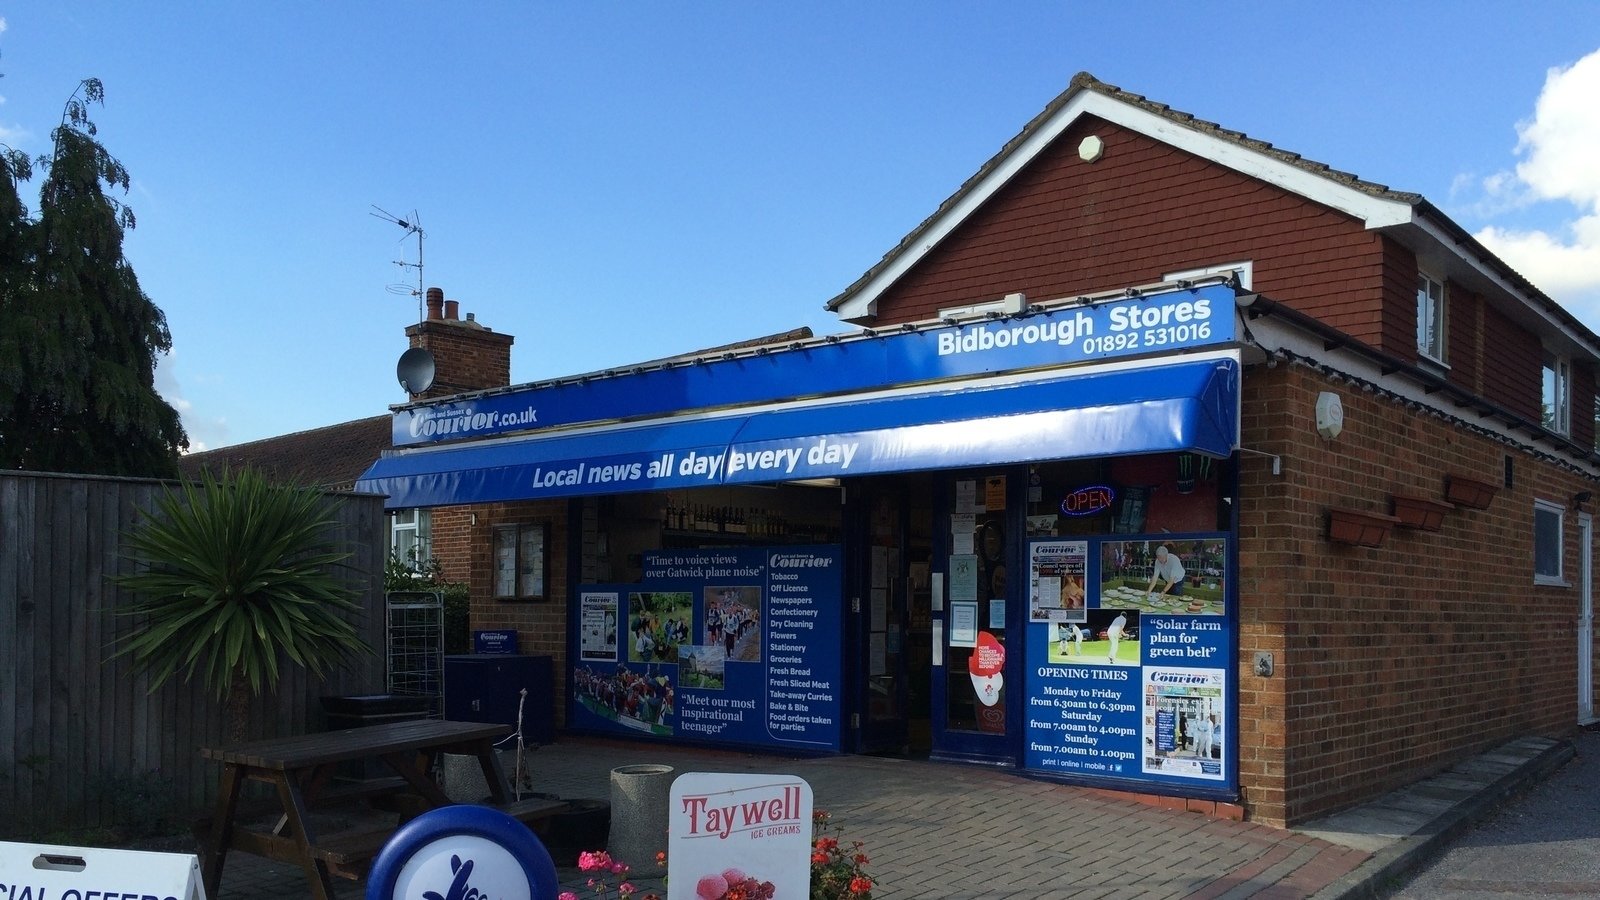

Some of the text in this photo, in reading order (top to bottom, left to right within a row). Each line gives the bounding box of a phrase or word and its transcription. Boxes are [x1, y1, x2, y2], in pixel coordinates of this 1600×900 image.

[938, 299, 1211, 355] Bidborough Stores
[1083, 321, 1211, 354] 01892 531016
[533, 439, 859, 488] Local news all day every day
[1065, 490, 1112, 512] OPEN
[674, 556, 684, 565] to
[685, 554, 710, 565] voice
[711, 553, 738, 564] views
[770, 553, 833, 568] Courier
[646, 569, 666, 578] over
[667, 567, 704, 578] Gatwick
[705, 566, 732, 579] plane
[770, 584, 809, 592] Off Licence
[770, 596, 813, 605] Newspapers
[770, 608, 819, 618] Confectionery
[770, 620, 814, 630] Dry Cleaning
[1150, 619, 1221, 631] “Solar farm
[770, 631, 797, 639] Flowers
[1150, 632, 1198, 645] plan for
[770, 643, 806, 653] Stationery
[1150, 646, 1217, 658] green belt”
[770, 655, 802, 663] Groceries
[770, 667, 811, 676] Fresh Bread
[1037, 667, 1128, 681] OPENING TIMES
[1150, 671, 1209, 684] Courier
[770, 678, 830, 689] Fresh Sliced Meat
[770, 690, 833, 701] Take-away Curries
[1043, 686, 1122, 700] Monday to Friday
[681, 693, 756, 709] “Meet our most
[769, 702, 809, 712] Bake & Bite
[1030, 697, 1136, 713] from 6.30am to 6.30pm
[681, 706, 743, 722] inspirational
[787, 714, 810, 723] orders
[811, 716, 832, 725] taken
[1061, 710, 1102, 722] Saturday
[681, 720, 727, 735] teenager”
[769, 721, 805, 731] for parties
[1030, 719, 1136, 737] from 7.00am to 4.00pm
[1064, 733, 1099, 746] Sunday
[1030, 742, 1135, 760] from 7.00am to 1.00pm
[1042, 758, 1056, 766] print
[1060, 759, 1079, 768] online
[1084, 762, 1106, 771] mobile
[682, 786, 801, 839] Taywell
[751, 825, 801, 840] ICE CREAMS
